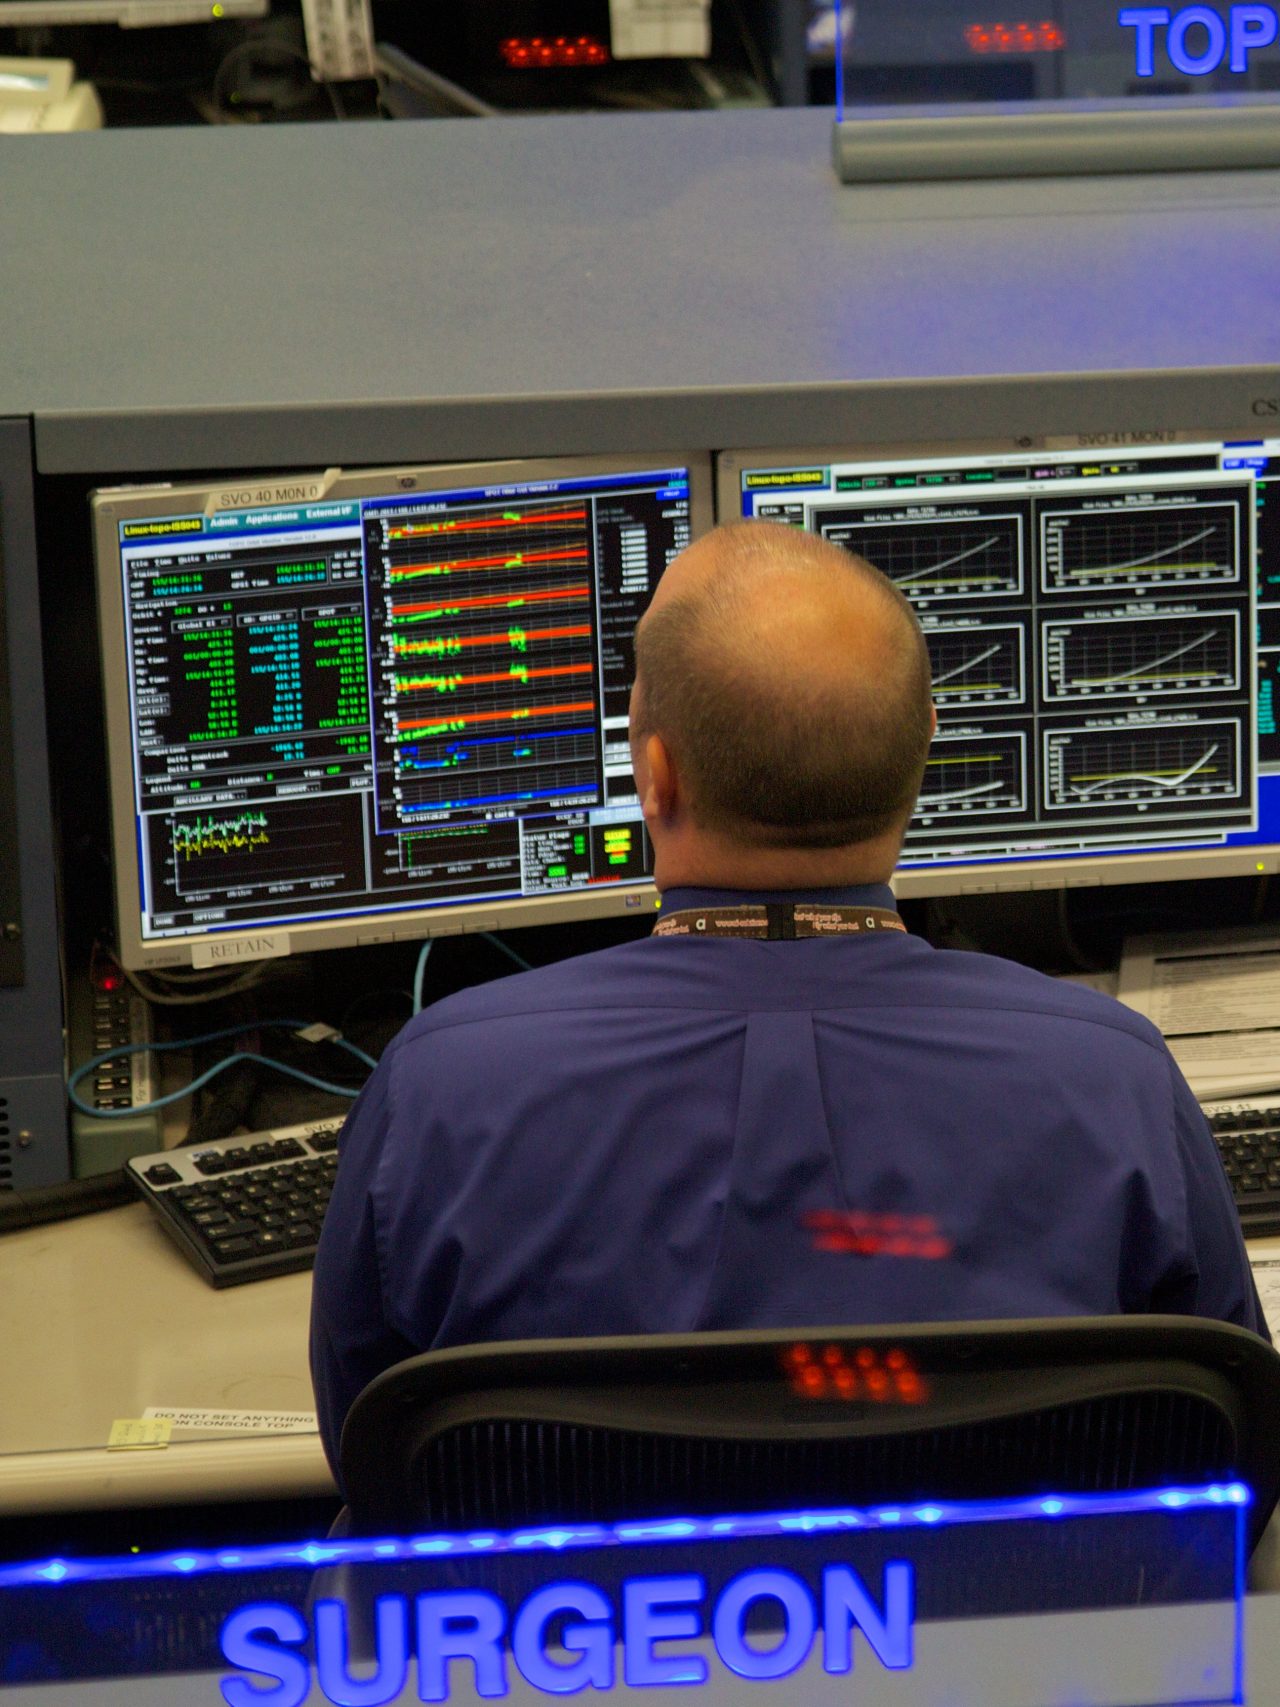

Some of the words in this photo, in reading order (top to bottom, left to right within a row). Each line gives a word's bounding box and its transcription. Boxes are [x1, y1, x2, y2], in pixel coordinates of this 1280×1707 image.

[221, 491, 252, 507] SVO
[255, 490, 272, 503] 40
[309, 485, 318, 496] 0
[210, 517, 239, 528] Admin
[246, 511, 299, 526] Applications
[305, 507, 341, 520] External
[210, 937, 276, 959] RETAIN
[1203, 1105, 1232, 1114] SVO
[1236, 1103, 1252, 1111] 41
[304, 1121, 335, 1133] SVO
[179, 1412, 208, 1420] NOT
[241, 1414, 315, 1424] ANYTHING
[194, 1420, 261, 1428] CONSOLE
[218, 1558, 915, 1707] SURGEON
